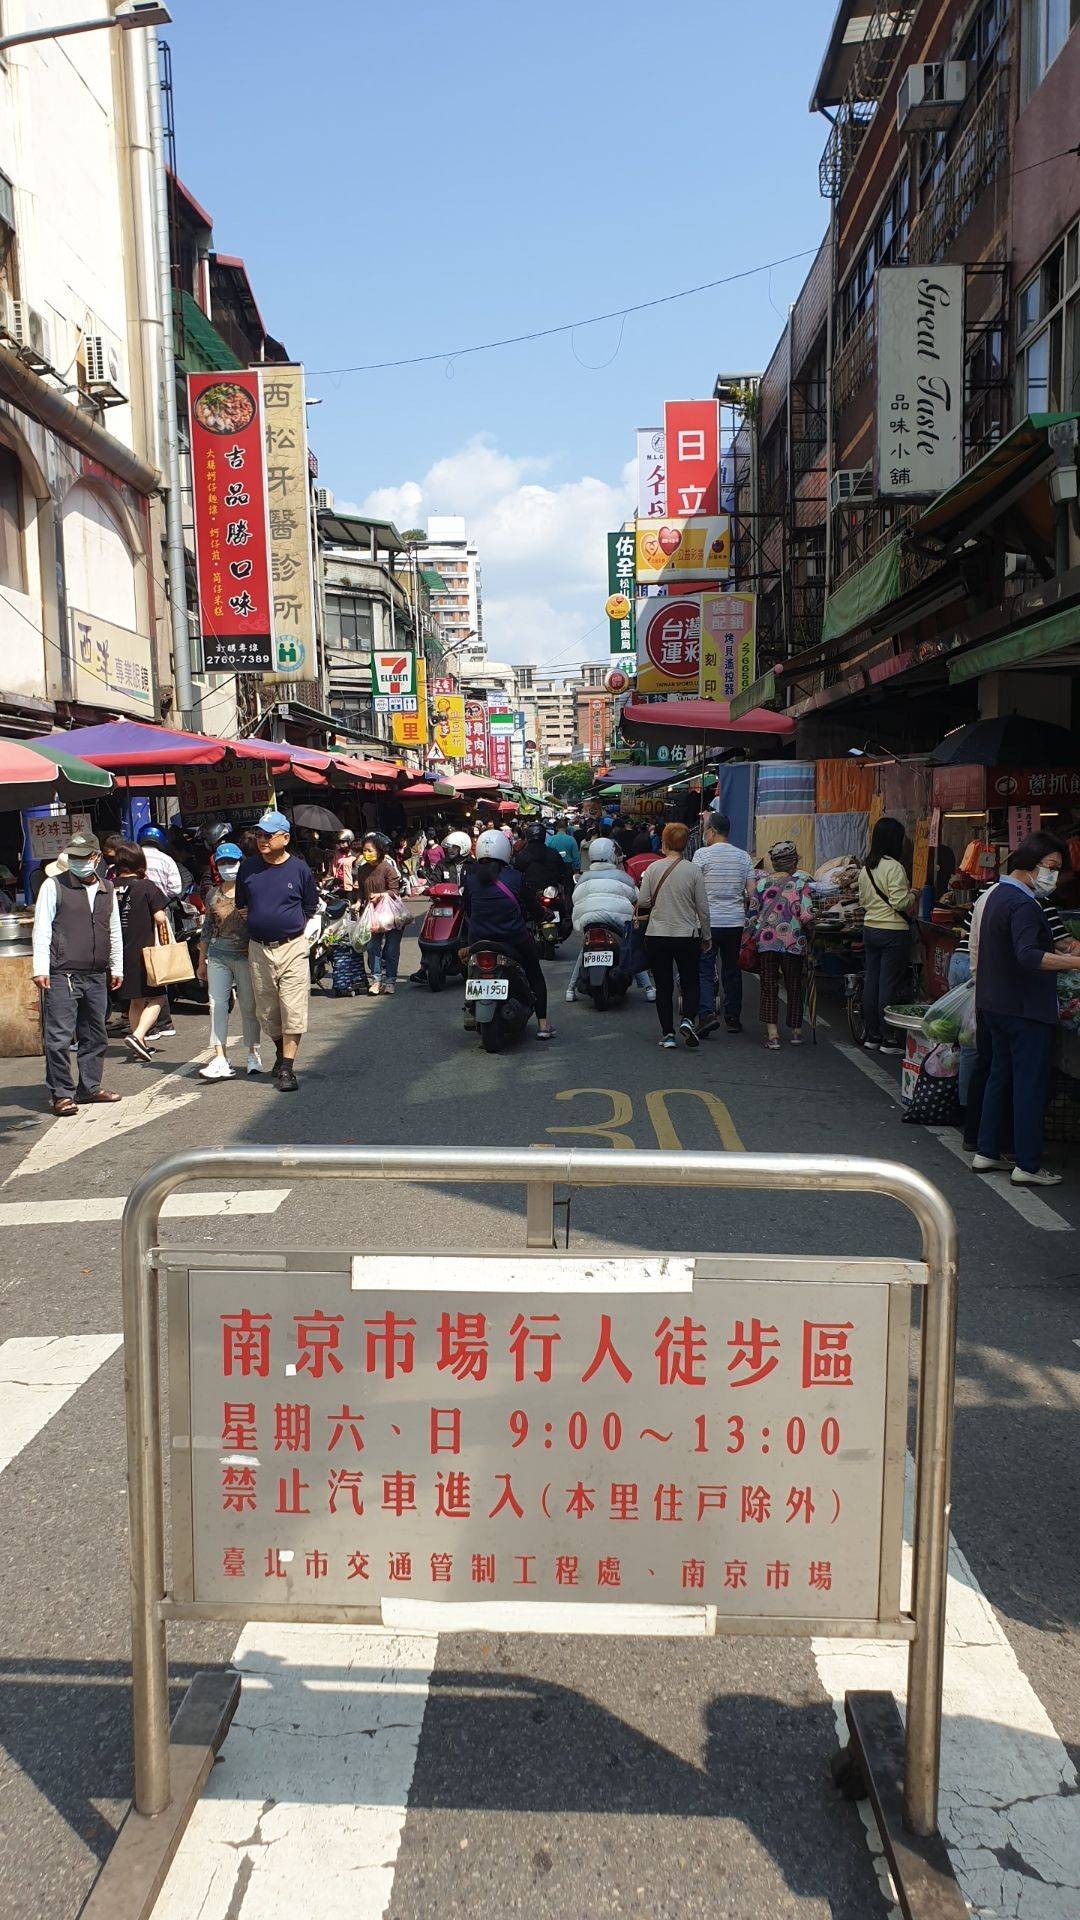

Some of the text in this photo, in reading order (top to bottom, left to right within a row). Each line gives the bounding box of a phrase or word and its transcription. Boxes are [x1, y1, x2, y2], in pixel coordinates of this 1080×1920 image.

[916, 278, 951, 457] Great Taste
[263, 381, 304, 626] 西松牙醫診所
[677, 430, 707, 515] 日立
[223, 445, 257, 619] 吉品勝口味
[615, 535, 635, 578] 佑全
[206, 653, 271, 665] 2760-7389
[704, 652, 717, 694] 刻印
[219, 1307, 855, 1389] 南京市場行人徒步區
[221, 1401, 462, 1455] 星期六、日
